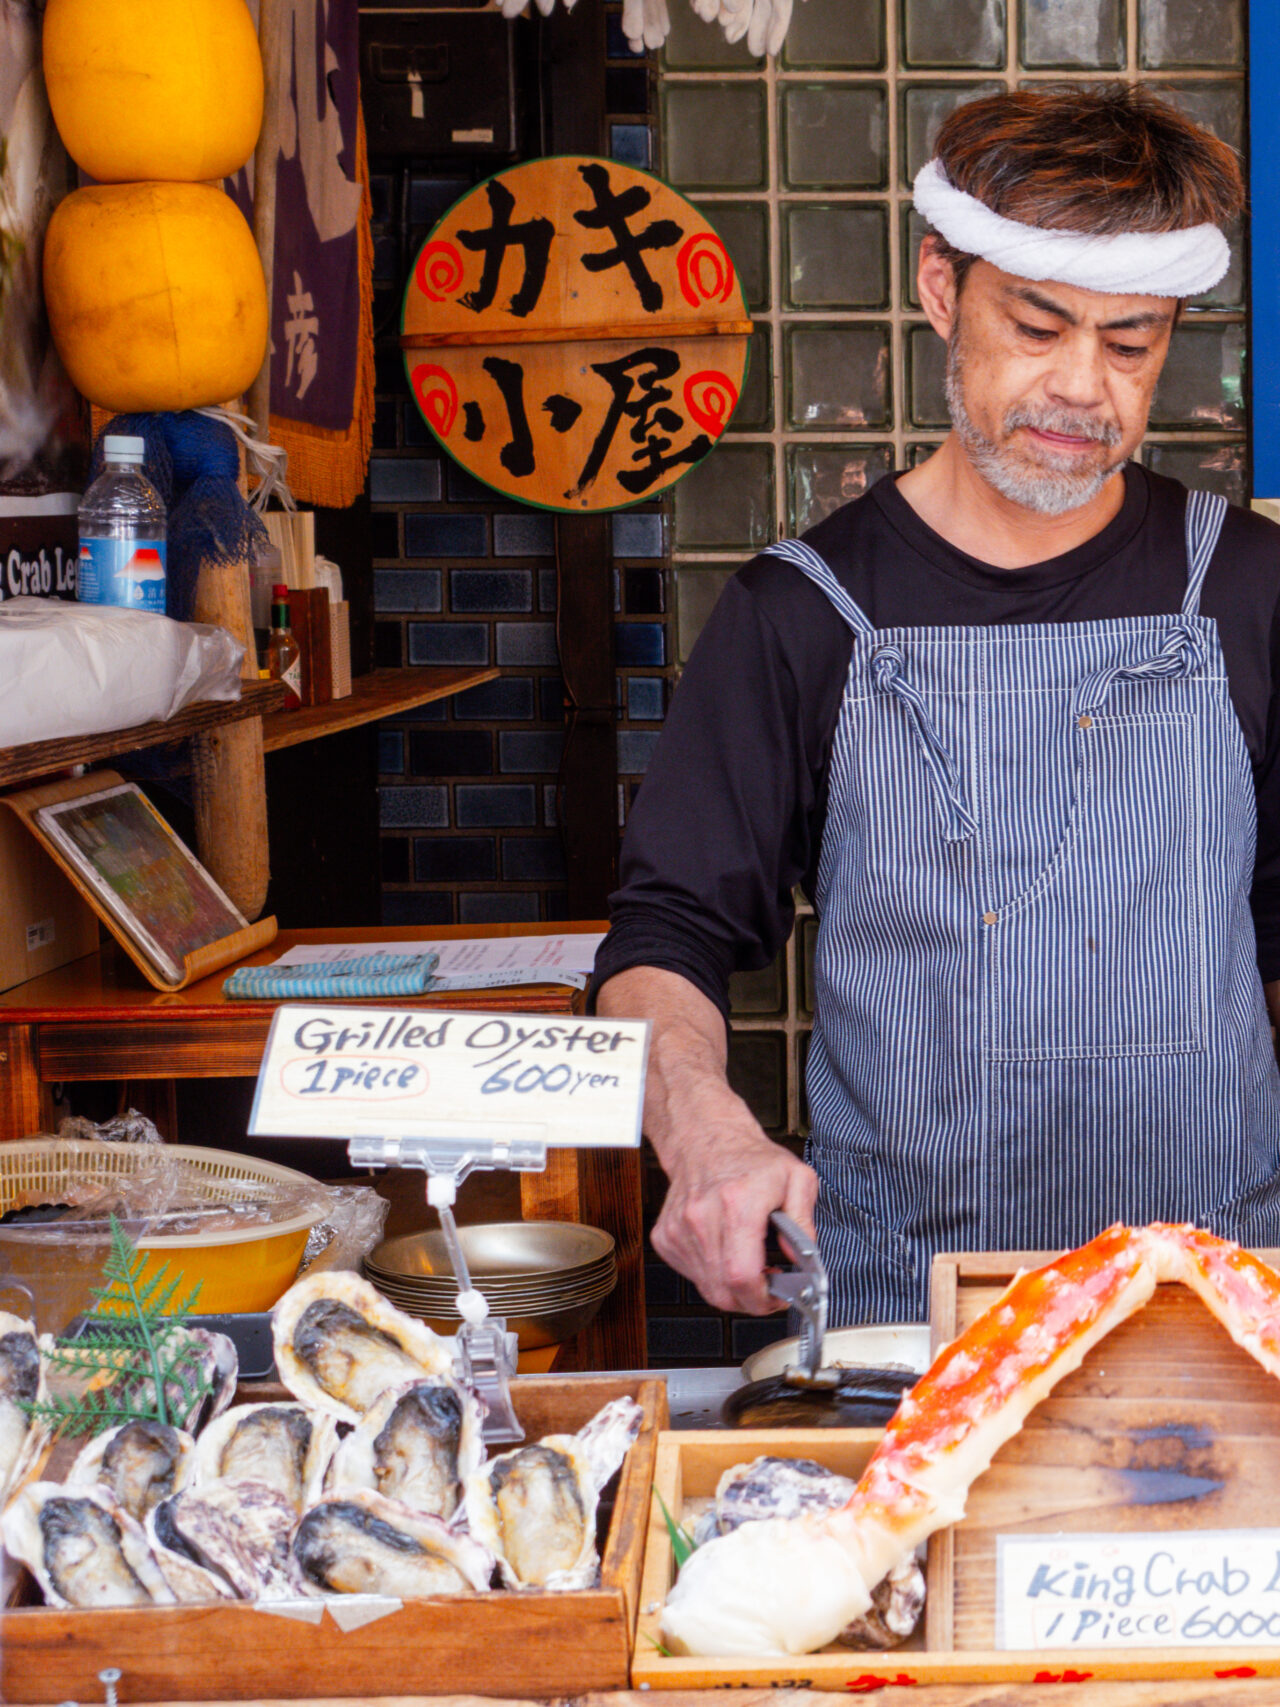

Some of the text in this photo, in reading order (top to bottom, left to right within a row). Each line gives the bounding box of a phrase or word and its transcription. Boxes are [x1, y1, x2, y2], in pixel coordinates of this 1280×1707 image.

[456, 163, 685, 318] カキ
[463, 347, 713, 499] 小屋
[8, 548, 51, 596] Crab
[55, 547, 79, 598] Le
[294, 1015, 638, 1068] Grilled Oyster
[1025, 1560, 1137, 1608] King
[1144, 1551, 1250, 1598] Crab
